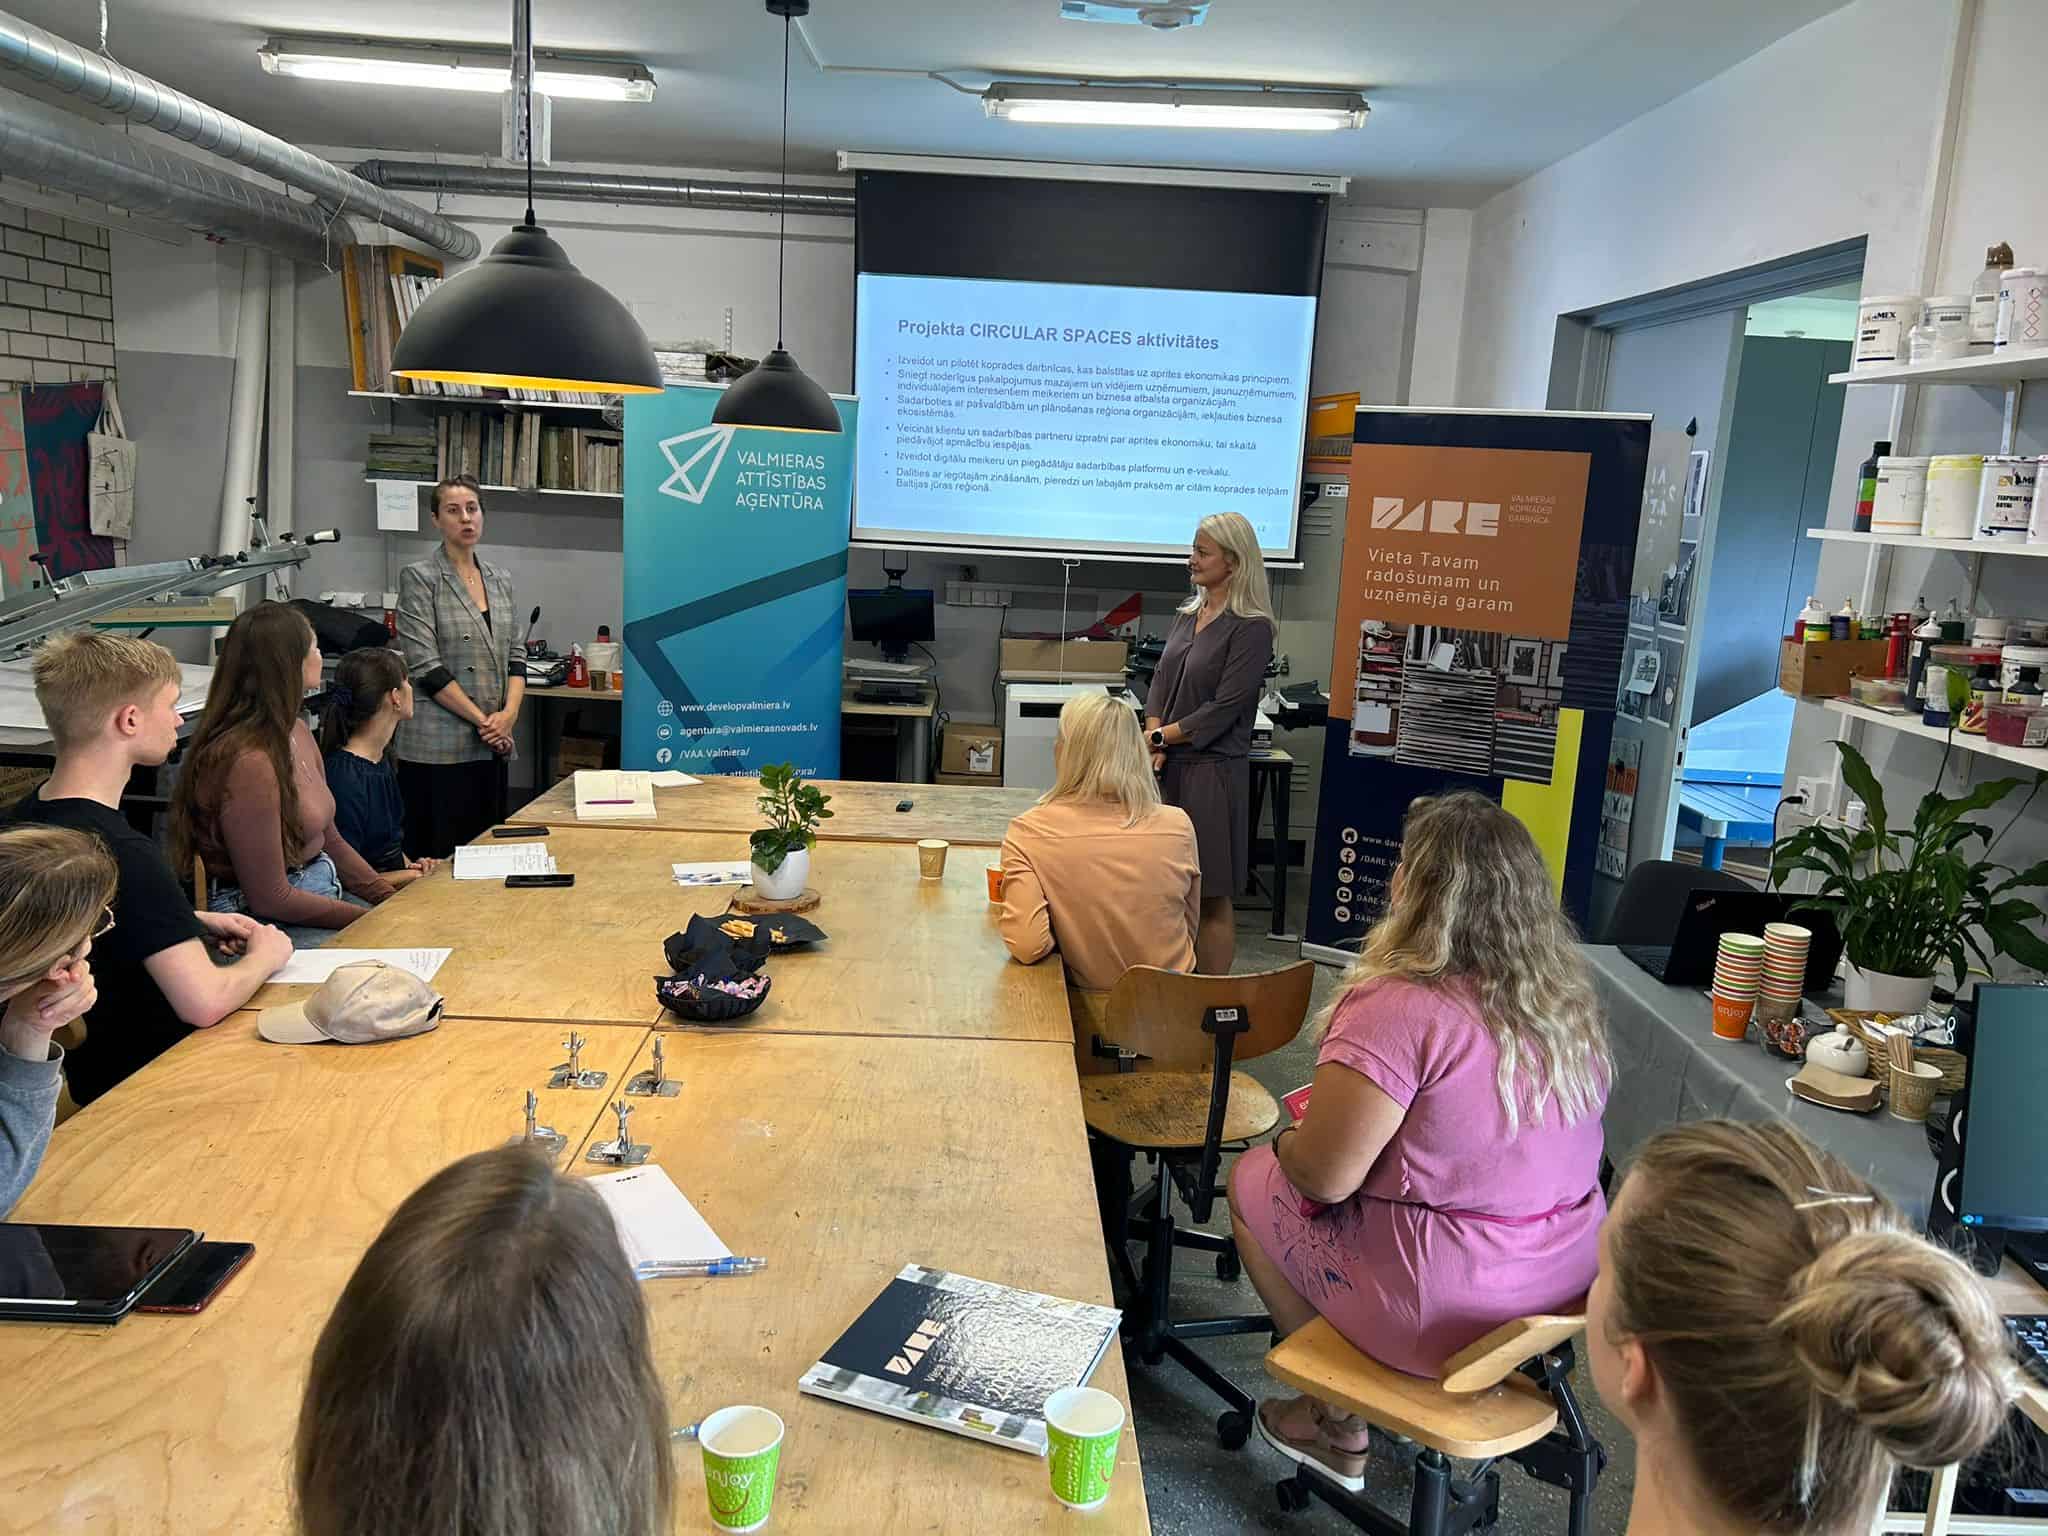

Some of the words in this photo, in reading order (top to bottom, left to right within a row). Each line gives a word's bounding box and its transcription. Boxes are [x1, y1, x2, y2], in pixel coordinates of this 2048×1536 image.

[898, 319, 965, 338] Projekta
[969, 323, 1058, 342] CIRCULAR
[1063, 328, 1132, 345] SPACES
[1136, 333, 1219, 350] aktivitātes
[898, 356, 935, 367] Izveidot
[937, 359, 948, 367] un
[951, 358, 979, 369] pilotēt
[981, 360, 1024, 372] koprades
[1026, 362, 1074, 374] darbnīcas,
[1077, 365, 1094, 375] kas
[1096, 366, 1135, 377] balstītas
[1150, 369, 1181, 380] aprites
[1184, 371, 1240, 382] ekonomikas
[1242, 374, 1293, 385] principiem.
[898, 369, 928, 381] Sniegt
[930, 371, 976, 383] noderīgus
[978, 374, 1042, 386] pakalpojumus
[1091, 381, 1103, 389] un
[1106, 380, 1143, 392] vidējiem
[1145, 384, 1210, 396] uzņēmumiem,
[1212, 387, 1297, 400] jaunuzņēmumiem,
[967, 386, 1029, 397] interesentiem
[1032, 389, 1079, 399] meikeriem
[1096, 392, 1132, 402] biznesa
[1134, 394, 1170, 404] atbalsta
[897, 395, 952, 407] Sadarboties
[954, 400, 964, 408] ar
[966, 399, 1025, 412] pašvaldībām
[1027, 404, 1039, 412] un
[1041, 403, 1094, 415] plānošanas
[1096, 406, 1130, 417] reģiona
[1132, 408, 1199, 421] organizācijām,
[1247, 413, 1282, 424] biznesa
[896, 424, 934, 434] Veicināt
[935, 425, 965, 435] klientu
[967, 429, 980, 437] un
[982, 427, 1032, 439] sadarbības
[1034, 431, 1073, 441] partneru
[1075, 433, 1107, 443] izpratni
[1110, 437, 1126, 445] par
[1128, 436, 1159, 447] aprites
[1215, 440, 1227, 448] tai
[1229, 440, 1257, 450] skaitā
[896, 435, 944, 447] piedāvājot
[946, 437, 990, 449] apmācību
[992, 441, 1032, 452] iespējas.
[737, 451, 825, 470] VALMIERAS
[896, 452, 932, 462] Izveidot
[968, 456, 1005, 465] meikeru
[1021, 457, 1073, 469] piegādātāju
[1076, 461, 1126, 472] sadarbības
[1128, 464, 1171, 475] platformu
[1173, 467, 1185, 475] un
[1187, 466, 1230, 477] e-veikalu.
[735, 470, 826, 490] ATTĪSTĪBAS
[896, 467, 929, 478] Dalīties
[944, 470, 989, 482] iegūtajām
[991, 472, 1042, 484] zināšanām,
[1044, 476, 1080, 486] pieredzi
[1082, 479, 1094, 487] un
[1096, 479, 1132, 490] labajām
[1134, 480, 1173, 491] praksēm
[1175, 484, 1184, 492] ar
[1187, 483, 1212, 492] citām
[1214, 484, 1256, 495] koprades
[1257, 487, 1289, 497] telpām
[896, 478, 929, 489] Baltijas
[930, 480, 953, 491] jūras
[955, 483, 991, 494] reģionā.
[735, 492, 824, 511] AĢENTŪRA
[1511, 495, 1556, 505] VALMIERAS
[1370, 496, 1501, 537] DARE
[1367, 547, 1413, 565] Vieta
[1420, 552, 1479, 570] Tavam
[1366, 569, 1471, 590] radošumam
[1478, 578, 1501, 591] un
[1364, 587, 1449, 607] uzņēmēja
[1456, 598, 1513, 613] garam
[680, 701, 791, 714] www.developvalmiera.lv
[679, 723, 818, 737] agentura@valmierasnovads.lv
[884, 1319, 945, 1376] DARE
